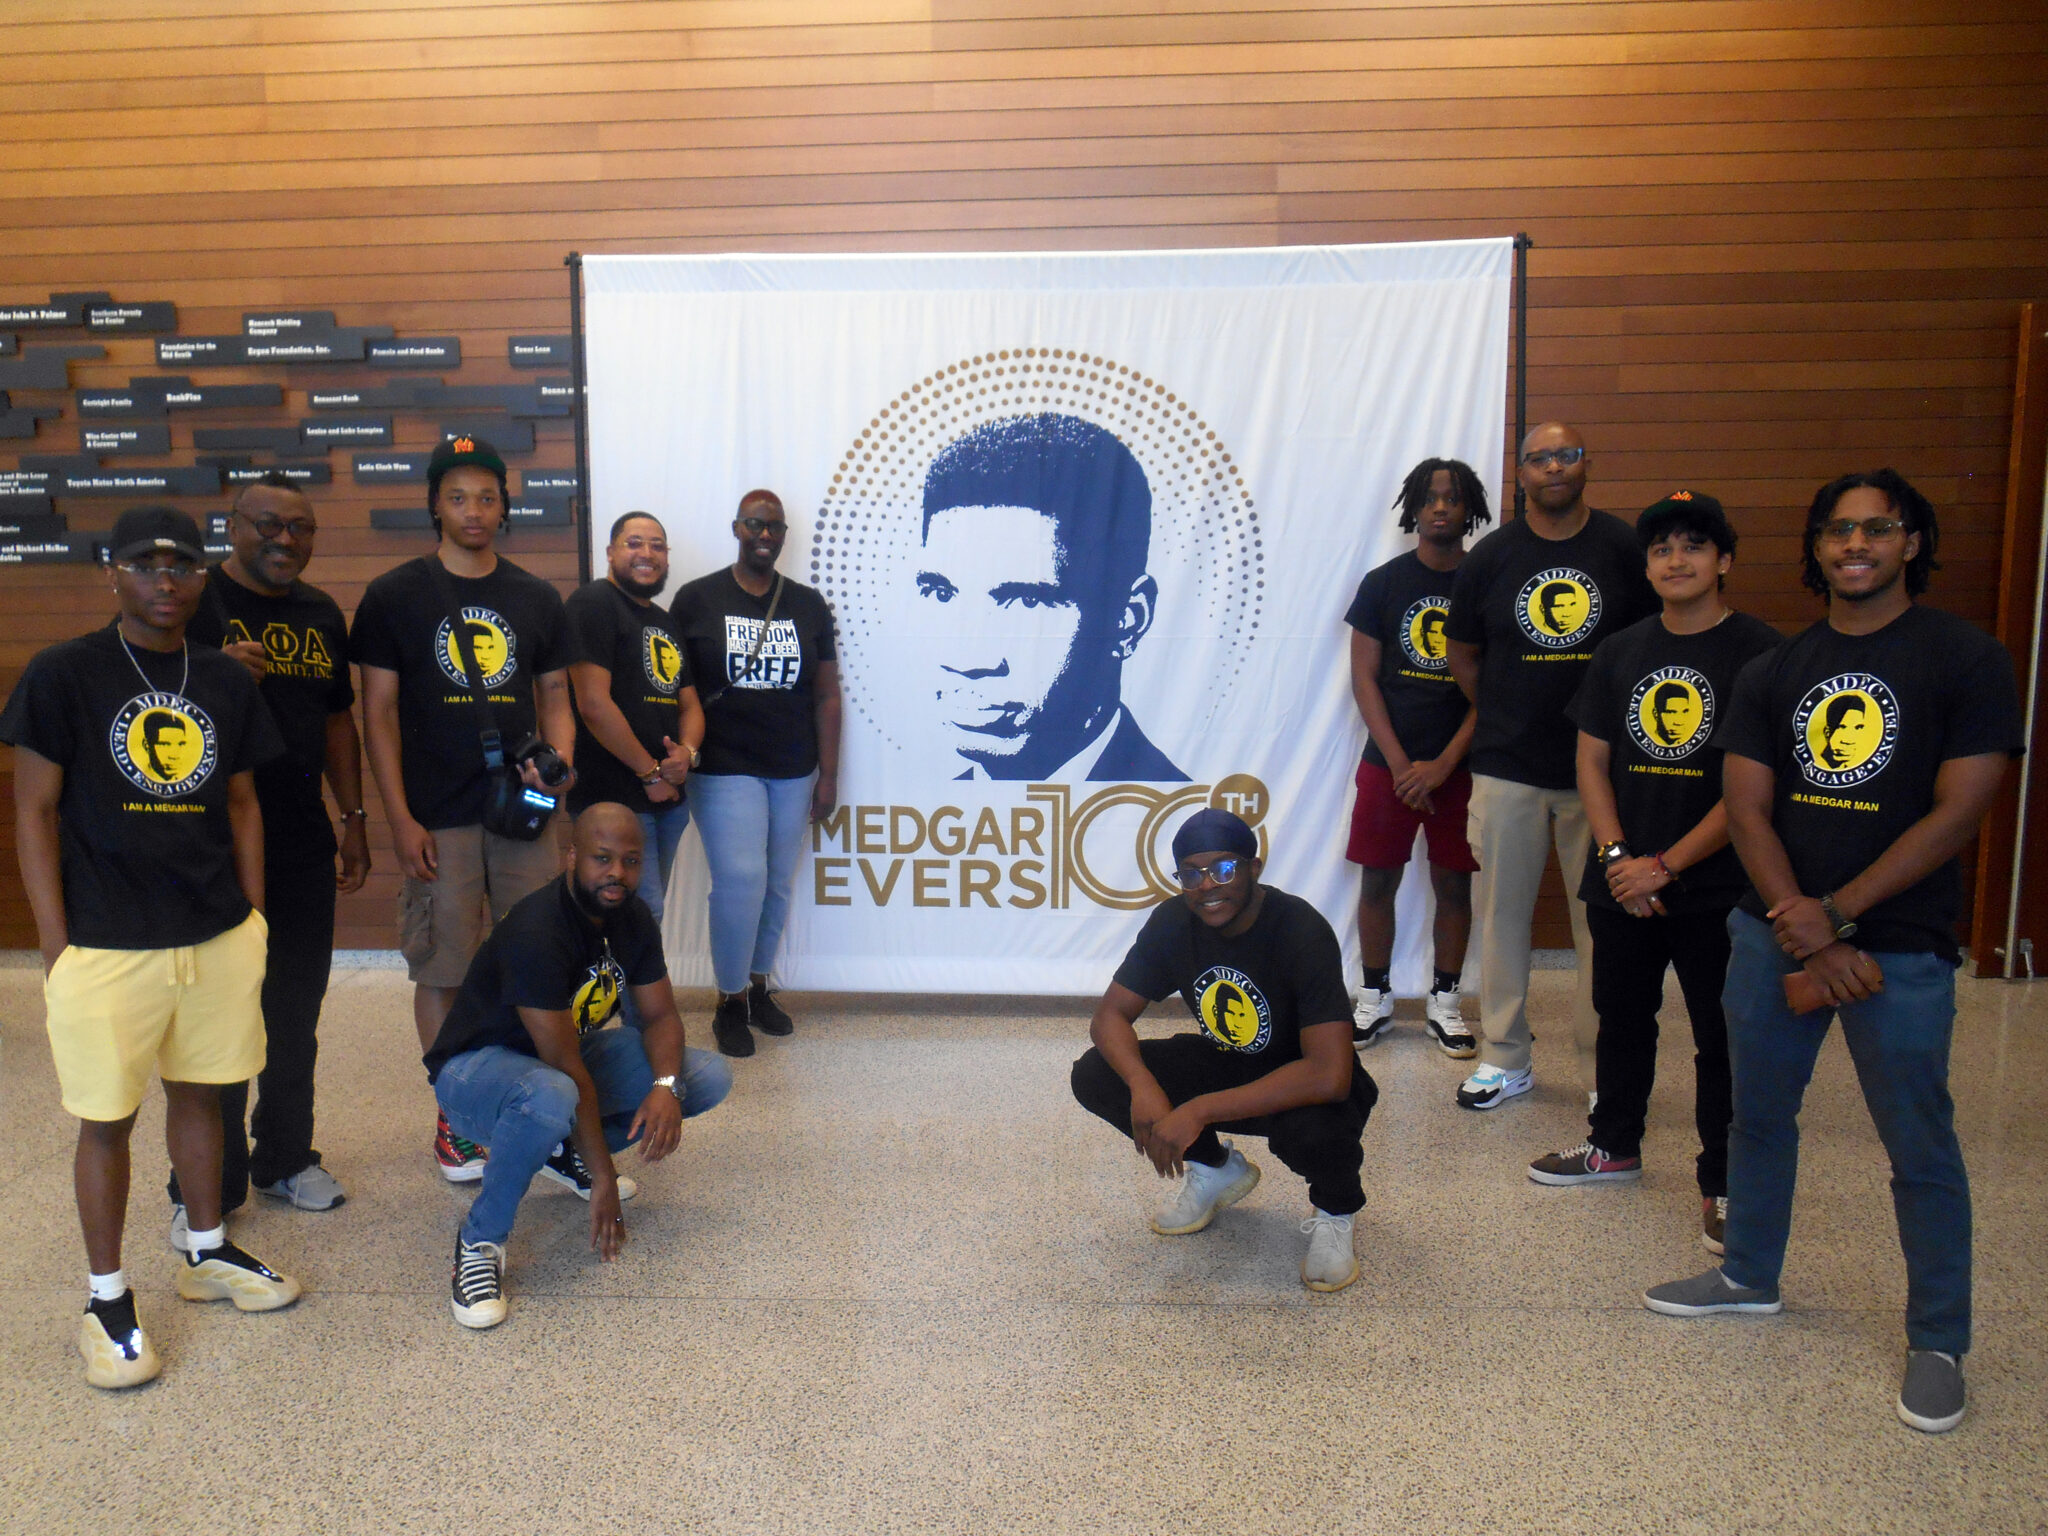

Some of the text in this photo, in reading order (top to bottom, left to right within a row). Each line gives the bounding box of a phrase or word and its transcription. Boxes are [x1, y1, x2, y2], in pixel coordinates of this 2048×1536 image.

[160, 343, 196, 351] Foundation
[1420, 599, 1452, 610] MDE
[1530, 629, 1584, 646] ENGAGE
[1410, 650, 1448, 667] ENGAG
[728, 652, 800, 687] FREE
[1652, 668, 1704, 687] MDEC
[1640, 736, 1694, 758] ENGAGE
[1220, 792, 1260, 814] TH
[1854, 800, 1880, 812] MAN
[812, 805, 1044, 856] MEDGAR
[814, 857, 1047, 909] EVERS
